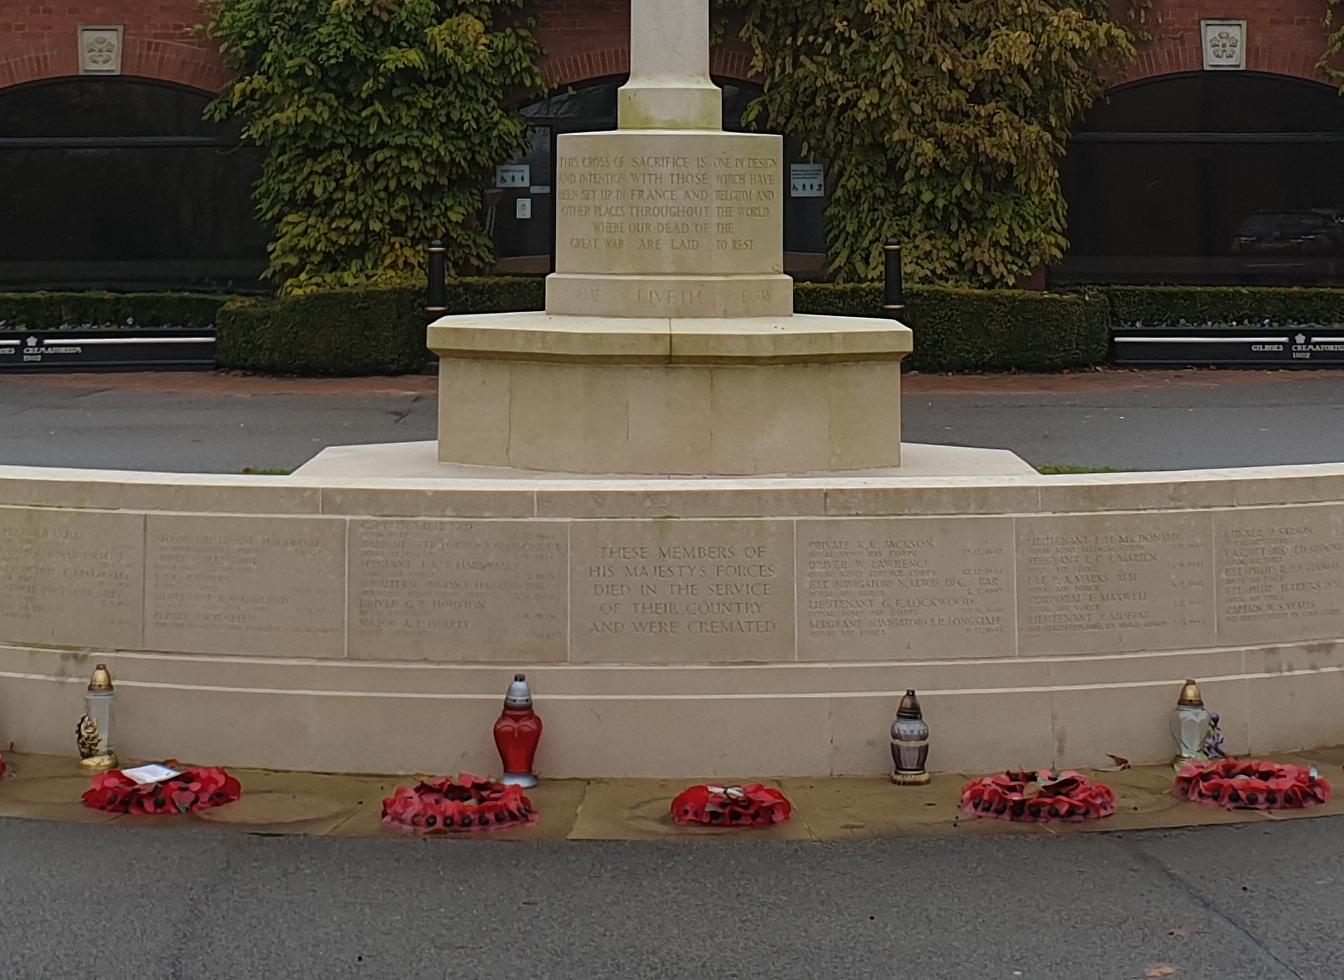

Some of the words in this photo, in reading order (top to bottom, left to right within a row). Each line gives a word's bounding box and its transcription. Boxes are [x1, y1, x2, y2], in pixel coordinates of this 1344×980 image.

[560, 157, 578, 168] THIS
[582, 157, 611, 168] CROSS
[614, 156, 625, 168] OF
[632, 157, 690, 168] SACRIFICE
[697, 157, 708, 168] IS
[714, 157, 732, 168] ONE
[735, 157, 744, 168] IN
[748, 158, 777, 169] DESIGN
[579, 173, 626, 184] INTENTION
[631, 173, 663, 184] WITH
[669, 173, 709, 184] THOSE
[715, 174, 746, 185] WHICH
[750, 174, 775, 185] HAVE
[582, 189, 597, 200] SET
[601, 189, 613, 200] UP
[616, 189, 625, 200] IN
[631, 189, 676, 200] FRANCE
[684, 190, 709, 200] AND
[715, 190, 752, 201] BELGIUM
[757, 190, 775, 201] AND
[561, 205, 590, 216] OTHER
[594, 205, 625, 217] PLACES
[629, 206, 710, 217] THROUGHOUT
[716, 206, 733, 217] THE
[737, 206, 770, 217] WORLD
[592, 222, 625, 233] WHERE
[628, 222, 652, 234] OUR
[657, 222, 690, 233] DEAD
[695, 222, 710, 233] OF
[716, 223, 733, 234] THE
[570, 238, 598, 249] GREAT
[601, 238, 624, 250] WAR
[638, 239, 662, 250] ARE
[671, 239, 699, 250] LAID
[716, 239, 727, 250] TO
[732, 239, 754, 250] REST
[600, 546, 648, 559] THESE
[659, 546, 735, 559] MEMBERS
[744, 546, 765, 559] OF
[589, 565, 615, 578] HIS
[625, 565, 706, 578] MAJESTY'S
[716, 565, 776, 578] FORCES
[594, 584, 630, 596] DIED
[641, 584, 656, 596] IN
[668, 584, 698, 596] THE
[708, 583, 772, 596] SERVICE
[600, 602, 621, 615] OF
[631, 602, 679, 615] THEIR
[686, 602, 763, 616] COUNTRY
[590, 621, 625, 634] AND
[632, 621, 677, 634] WERE
[687, 620, 776, 633] CREMATED
